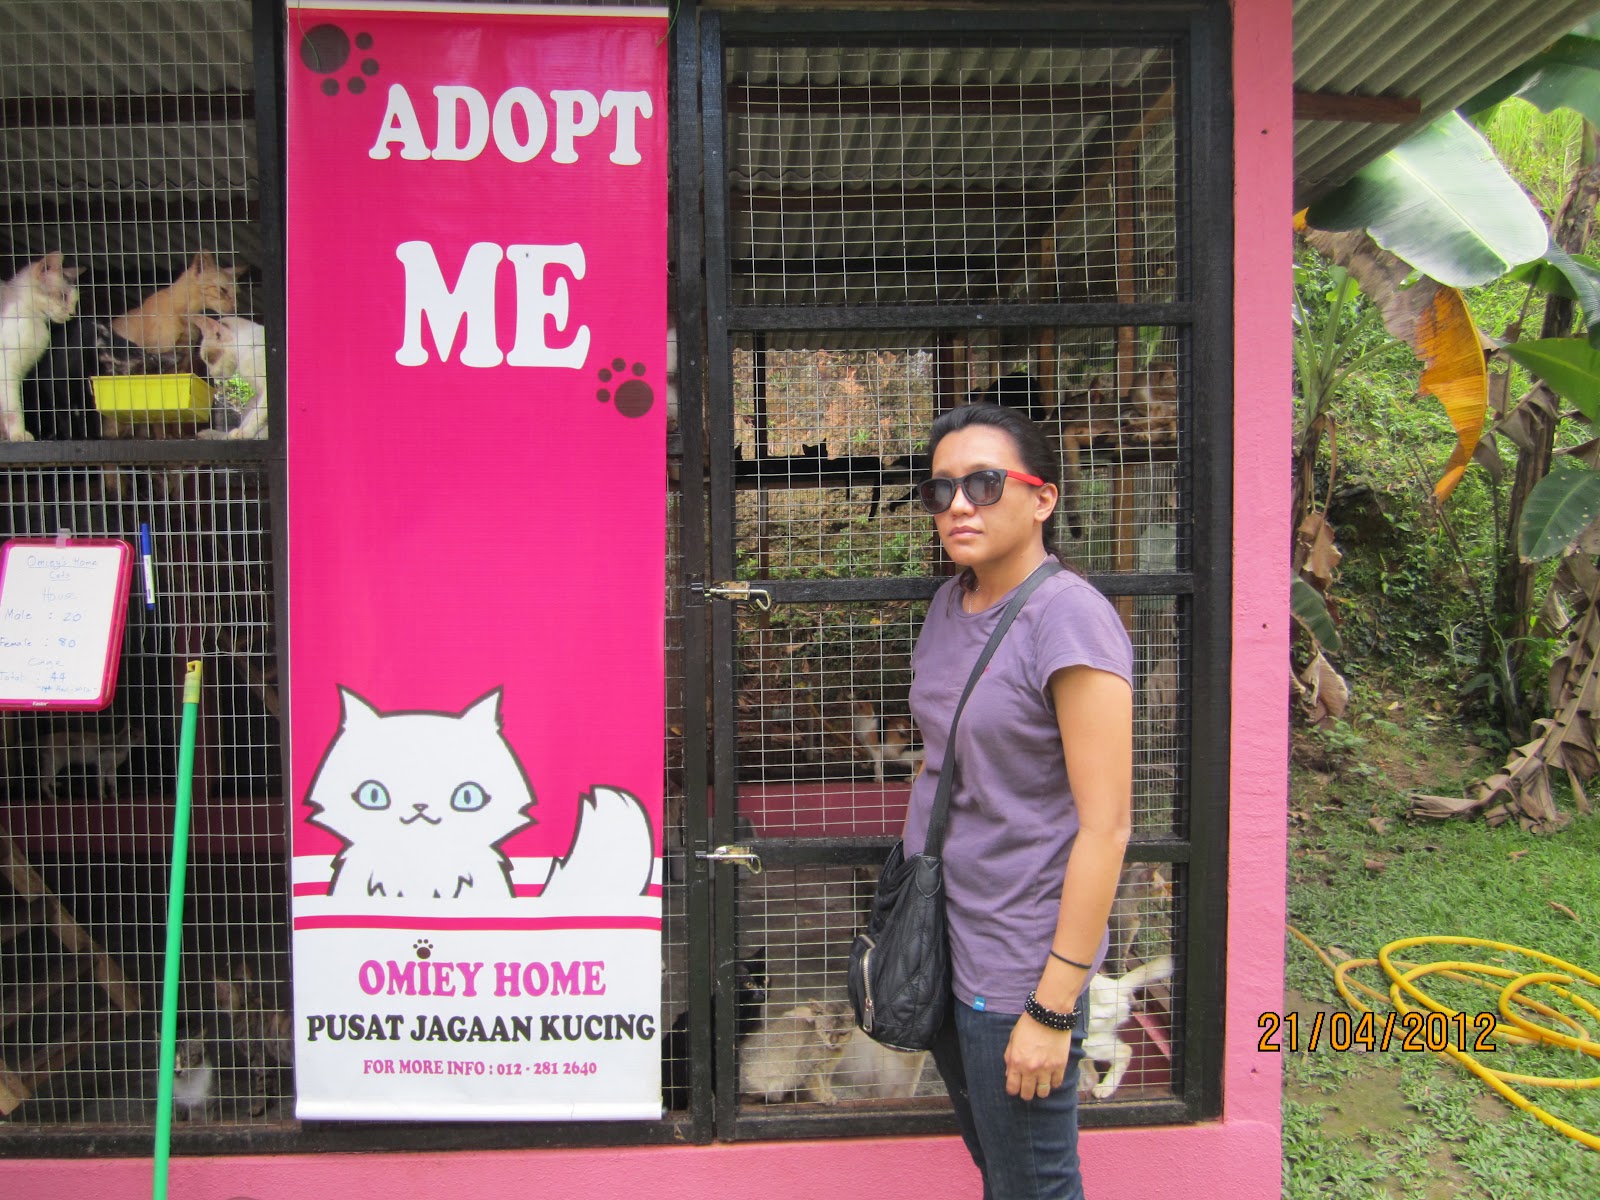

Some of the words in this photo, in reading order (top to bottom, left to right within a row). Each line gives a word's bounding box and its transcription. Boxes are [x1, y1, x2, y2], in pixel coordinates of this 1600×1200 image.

[369, 84, 653, 165] ADOPT
[396, 241, 591, 369] ME
[5, 608, 33, 620] Male
[63, 612, 83, 622] 20
[0, 636, 32, 648] Female
[58, 637, 76, 648] 80
[358, 960, 484, 997] OMIEY
[494, 960, 607, 997] HOME
[307, 1014, 404, 1042] PUSAT
[410, 1014, 533, 1043] JAGAAN
[540, 1013, 656, 1042] KUCING
[363, 1059, 395, 1075] FOR
[399, 1059, 444, 1075] MORE
[447, 1060, 485, 1076] INFO
[497, 1063, 522, 1076] 012
[533, 1062, 559, 1075] 281
[563, 1061, 598, 1076] 2640
